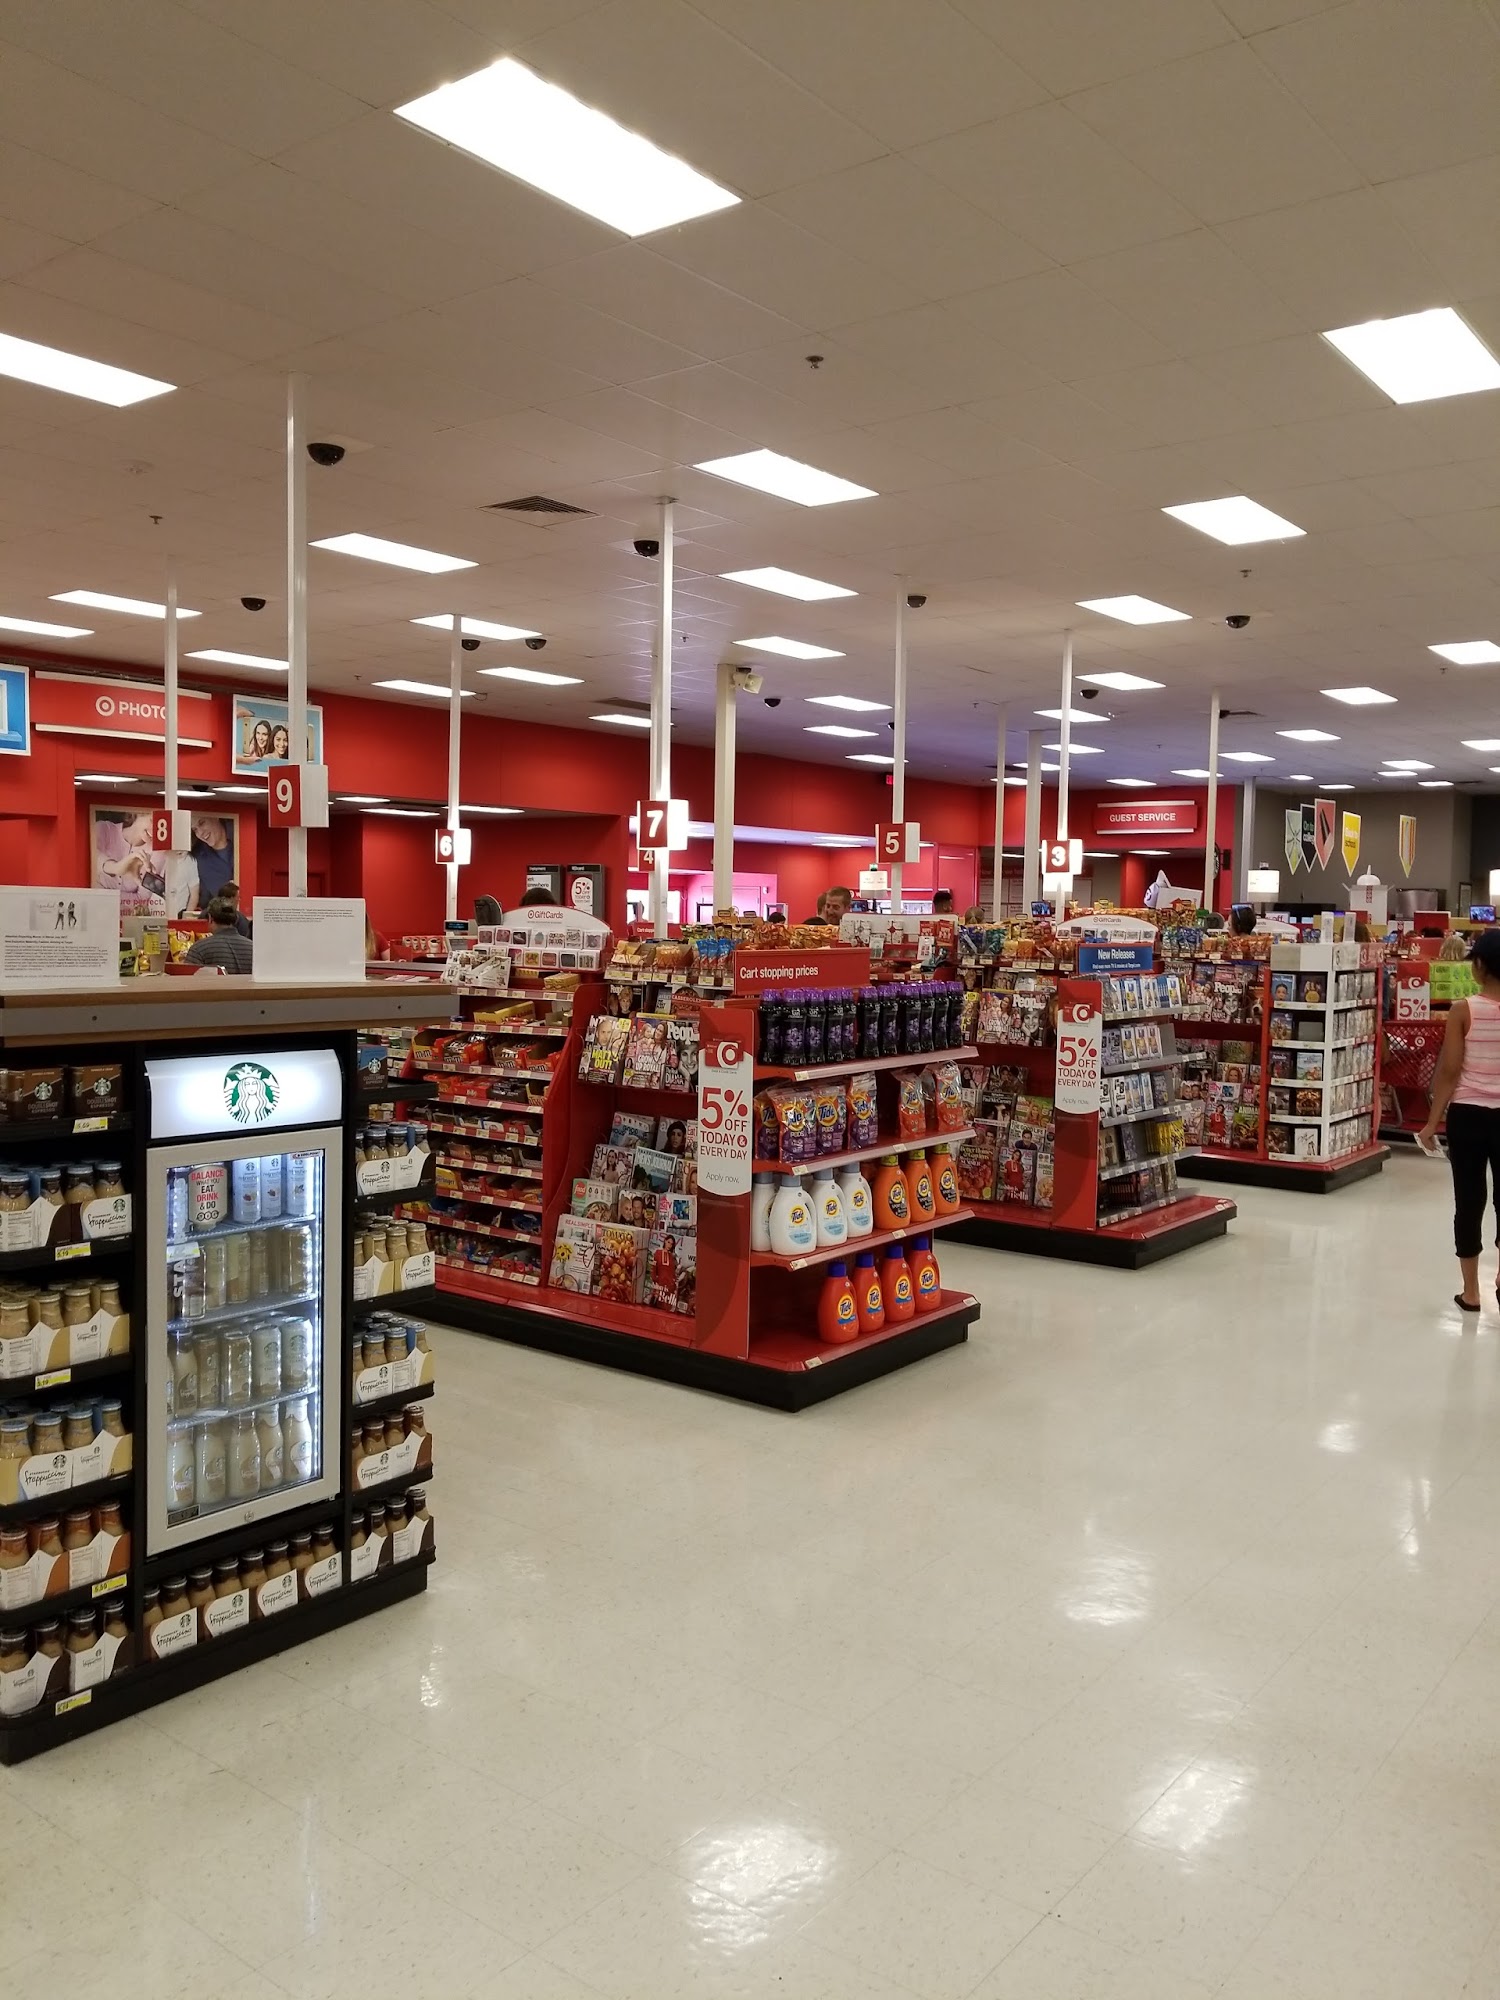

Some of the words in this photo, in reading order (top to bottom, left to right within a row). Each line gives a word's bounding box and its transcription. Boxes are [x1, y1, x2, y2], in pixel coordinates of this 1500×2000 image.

[276, 778, 294, 814] 9
[646, 810, 664, 838] 7
[1110, 814, 1136, 822] GUEST
[1138, 812, 1176, 822] SERVICE
[156, 818, 168, 842] 8
[440, 836, 452, 854] 6
[885, 832, 900, 854] 5
[643, 850, 654, 864] 4
[1051, 846, 1066, 866] 3
[534, 911, 563, 919] GiftCards
[1098, 949, 1110, 960] New
[1111, 949, 1135, 959] Releases
[740, 966, 758, 979] Cart
[760, 966, 794, 980] stopping
[795, 965, 818, 977] prices
[1399, 998, 1427, 1018] 5%
[1058, 1037, 1097, 1067] 5%
[1078, 1059, 1096, 1068] OFF
[1058, 1068, 1087, 1078] TODAY
[1088, 1070, 1096, 1079] &
[1058, 1078, 1080, 1087] EVERY
[1082, 1080, 1096, 1088] DAY
[700, 1087, 748, 1130] 5%
[818, 1104, 836, 1121] Tide
[725, 1119, 747, 1132] OFF
[701, 1130, 736, 1146] TODAY
[737, 1135, 747, 1147] &
[700, 1146, 729, 1159] EVERY
[731, 1148, 747, 1160] DAY
[190, 1169, 224, 1181] BALANCE
[706, 1172, 724, 1183] Apply
[201, 1185, 214, 1194] EAT
[196, 1193, 219, 1203] DRINK
[206, 1201, 216, 1209] DO
[854, 1195, 864, 1206] Tide
[826, 1204, 837, 1214] Tide
[792, 1211, 804, 1223] Tide
[921, 1272, 934, 1285] Tide
[897, 1280, 909, 1294] Tide
[869, 1291, 880, 1305] Tide
[840, 1301, 853, 1316] Tide
[24, 1470, 66, 1486] frappuccino
